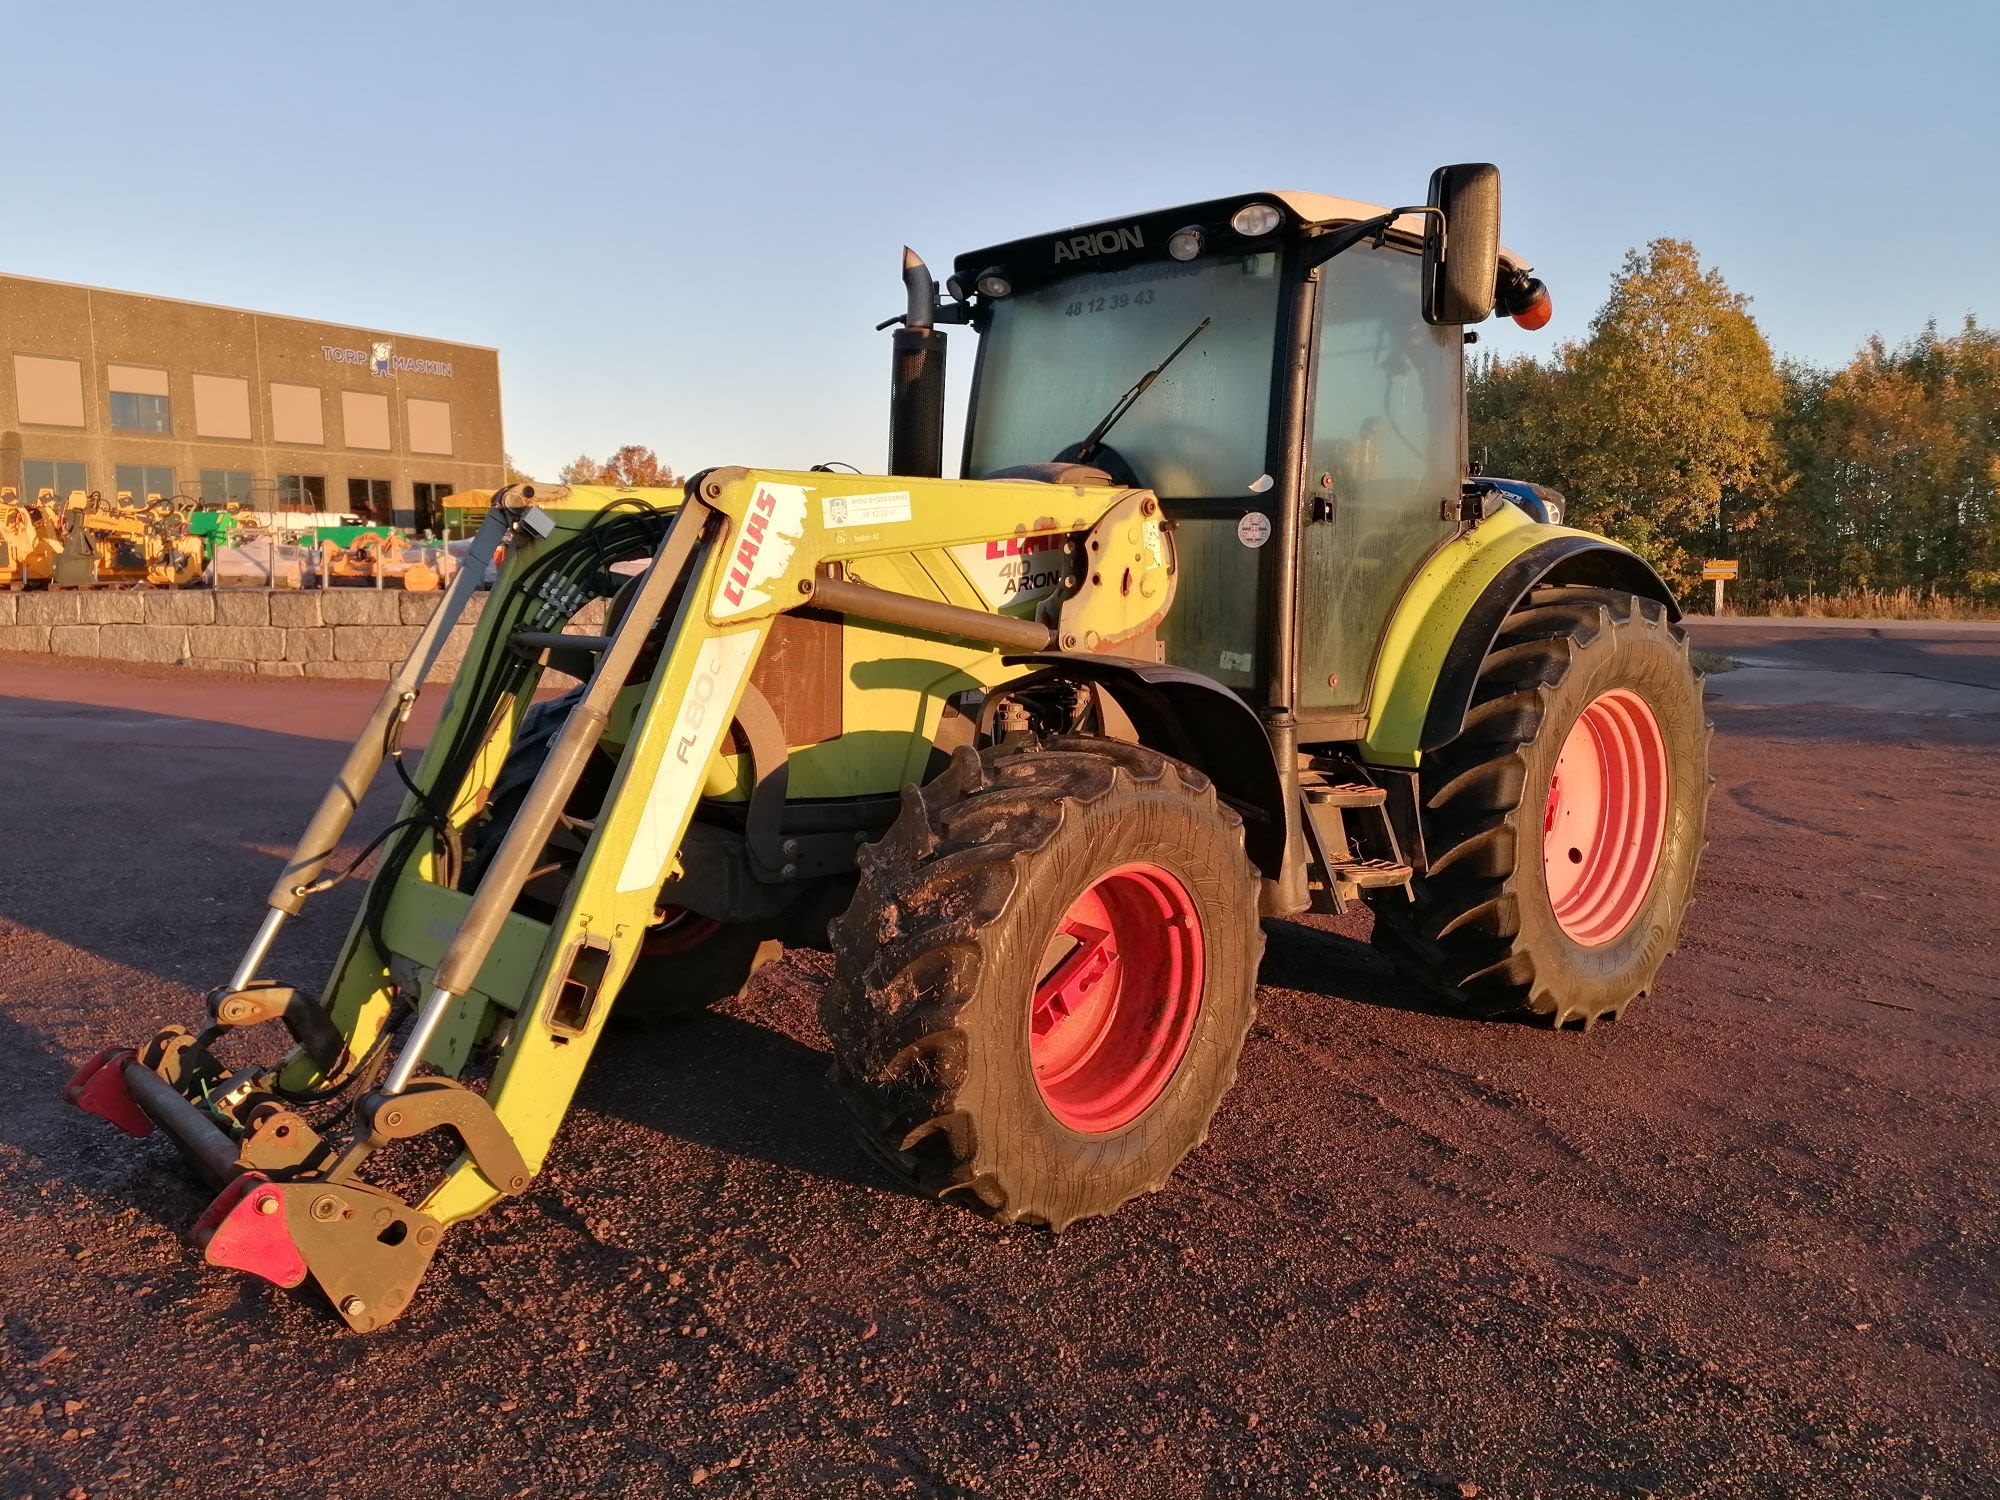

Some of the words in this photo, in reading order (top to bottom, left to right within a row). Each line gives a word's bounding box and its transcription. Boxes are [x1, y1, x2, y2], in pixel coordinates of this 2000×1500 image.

[1054, 225, 1145, 264] ARION
[1064, 301, 1083, 317] 48
[1088, 297, 1104, 313] 12
[1110, 293, 1129, 310] 39
[1133, 289, 1155, 306] 43
[321, 346, 368, 365] TORP
[392, 355, 453, 377] MASKIN
[723, 488, 777, 607] CLAAS
[999, 560, 1031, 579] 410
[1003, 570, 1059, 595] ARION
